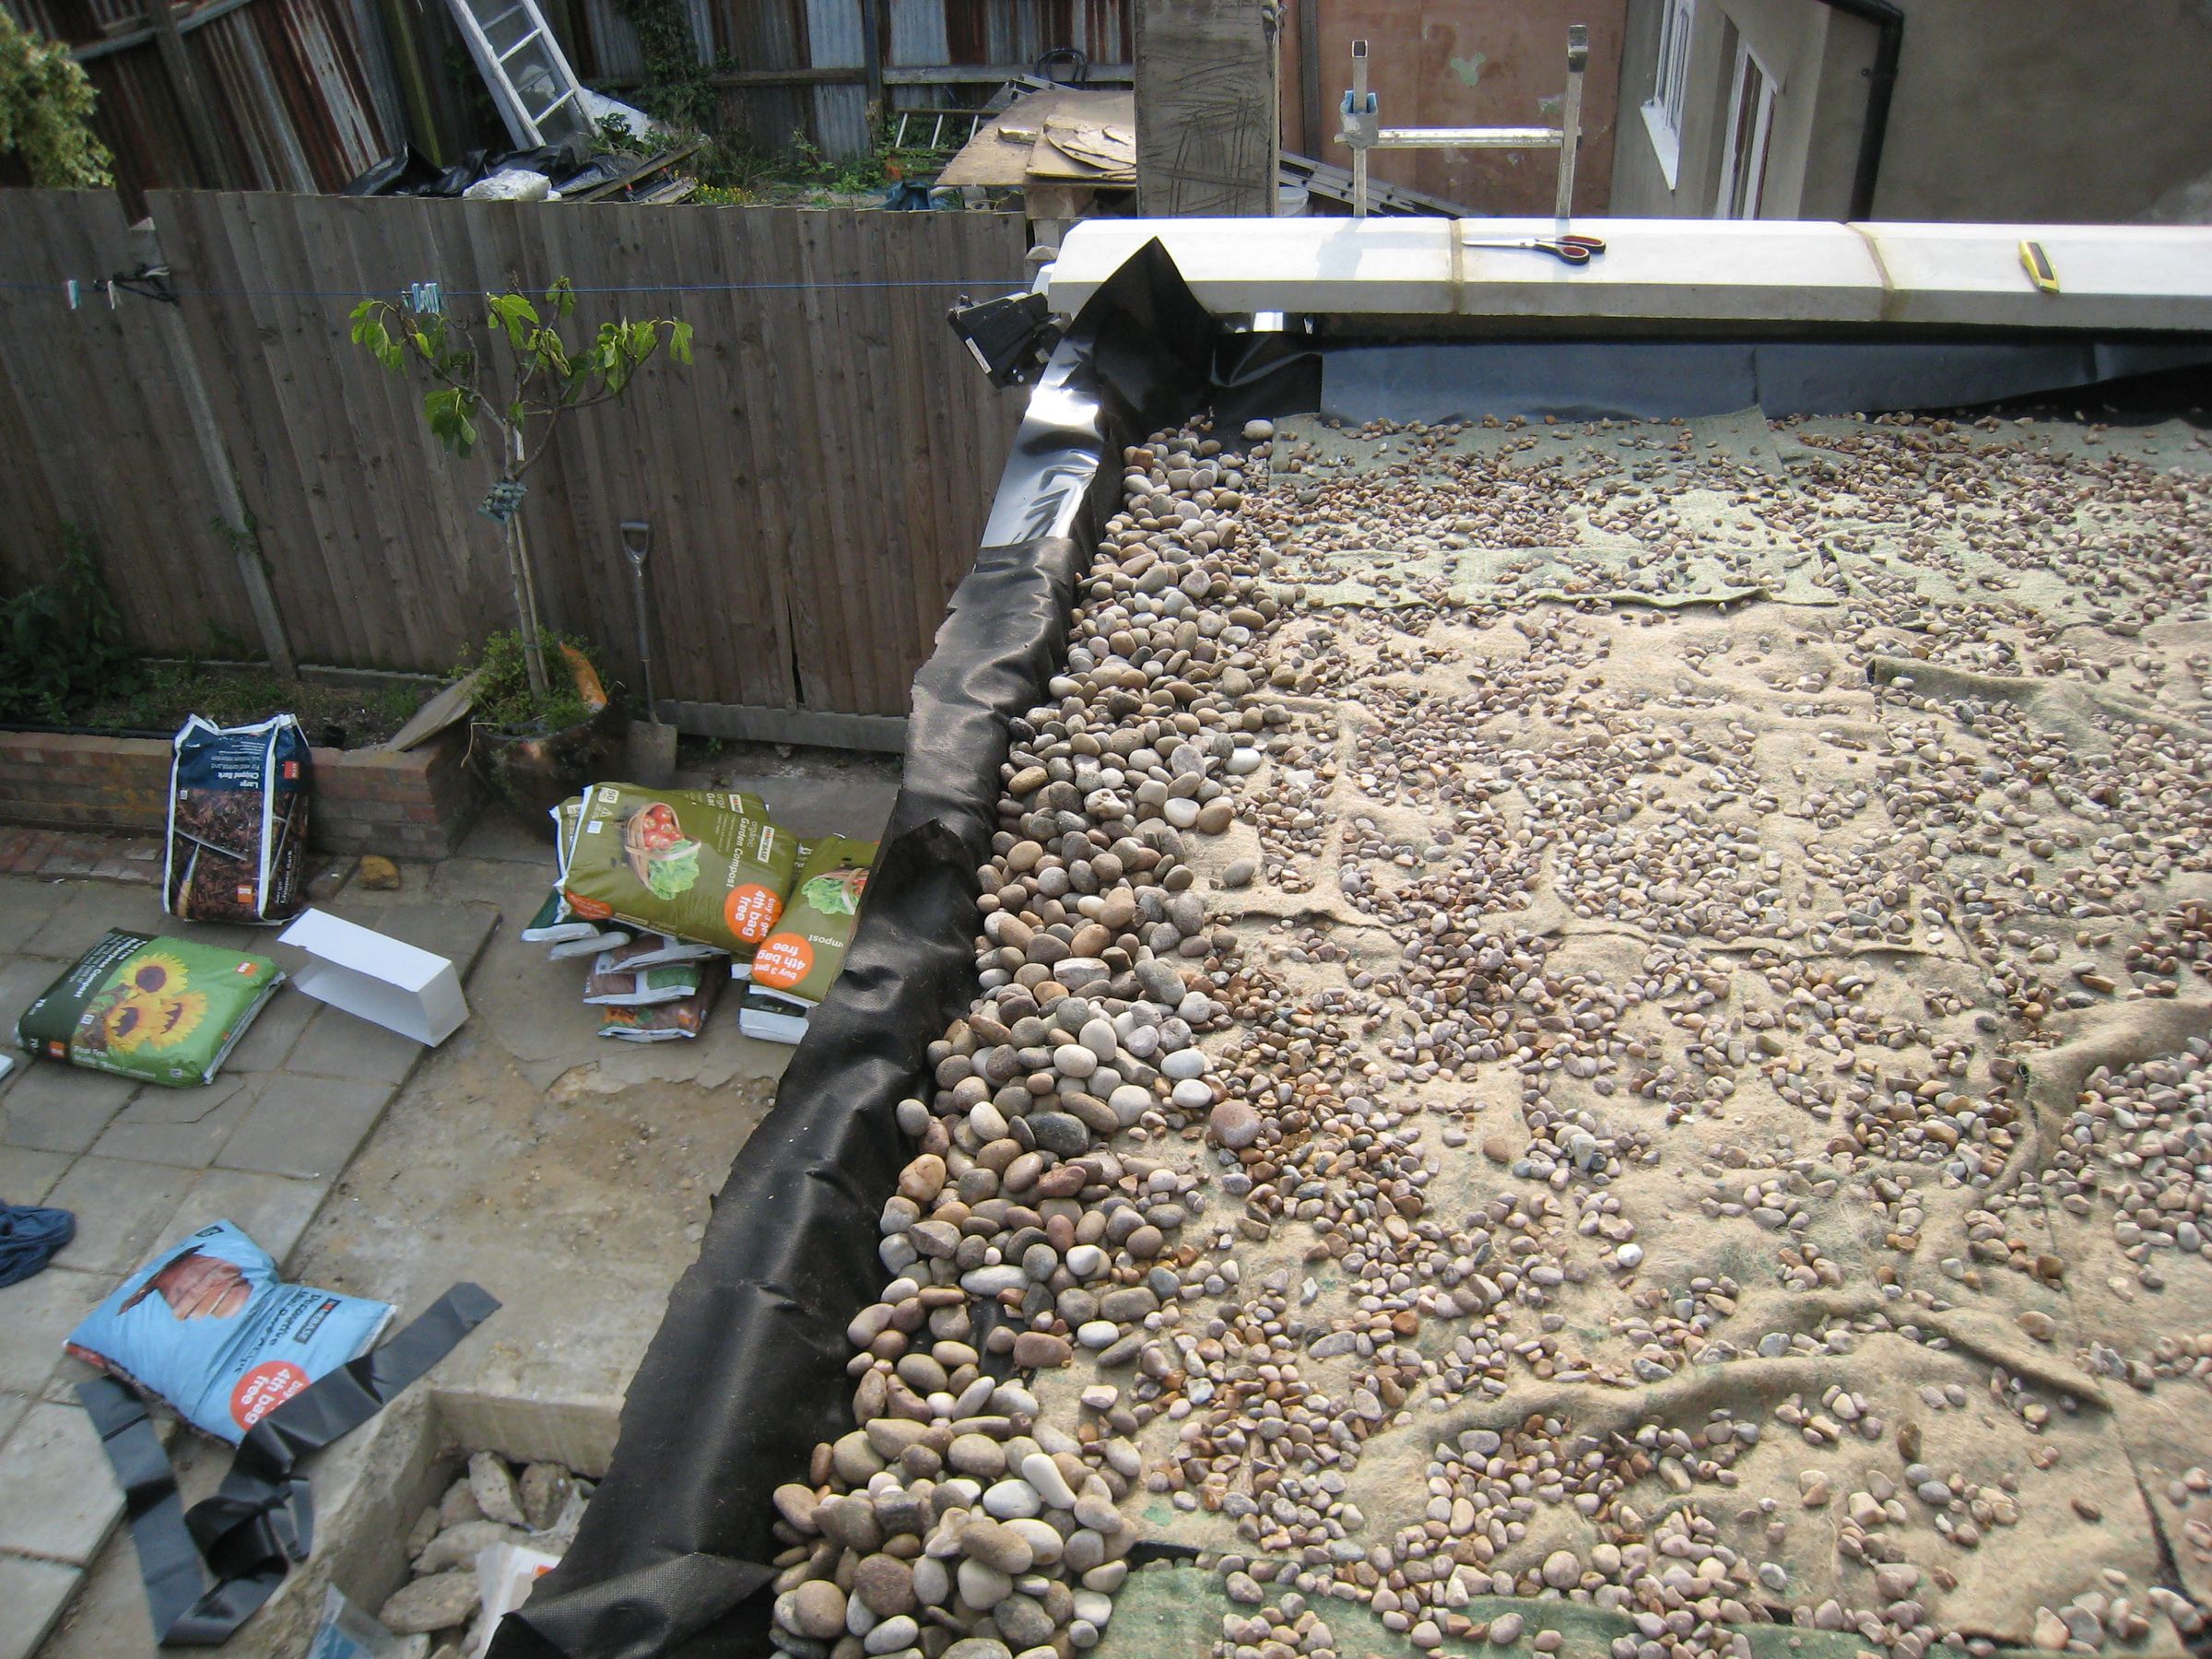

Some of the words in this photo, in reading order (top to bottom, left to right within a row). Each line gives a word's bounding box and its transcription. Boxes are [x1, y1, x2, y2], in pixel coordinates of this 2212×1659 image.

[218, 771, 233, 779] Bark
[233, 771, 260, 780] Chipped
[239, 780, 259, 789] Large
[606, 789, 616, 801] 50
[736, 817, 749, 847] Garden
[747, 819, 758, 848] organic
[725, 848, 743, 888] Compost
[752, 890, 767, 909] 4th
[769, 897, 777, 914] buy
[735, 896, 752, 922] free
[742, 911, 763, 937] bag
[759, 921, 770, 937] get
[756, 949, 782, 965] bag
[772, 942, 799, 957] free
[754, 963, 771, 971] get
[770, 966, 778, 975] 3
[783, 957, 806, 971] 4th
[778, 967, 797, 980] buy
[74, 968, 102, 998] Compost
[268, 1293, 322, 1347] Decorative
[266, 1368, 291, 1393] 4th
[240, 1374, 270, 1406] free
[243, 1393, 276, 1425] bag
